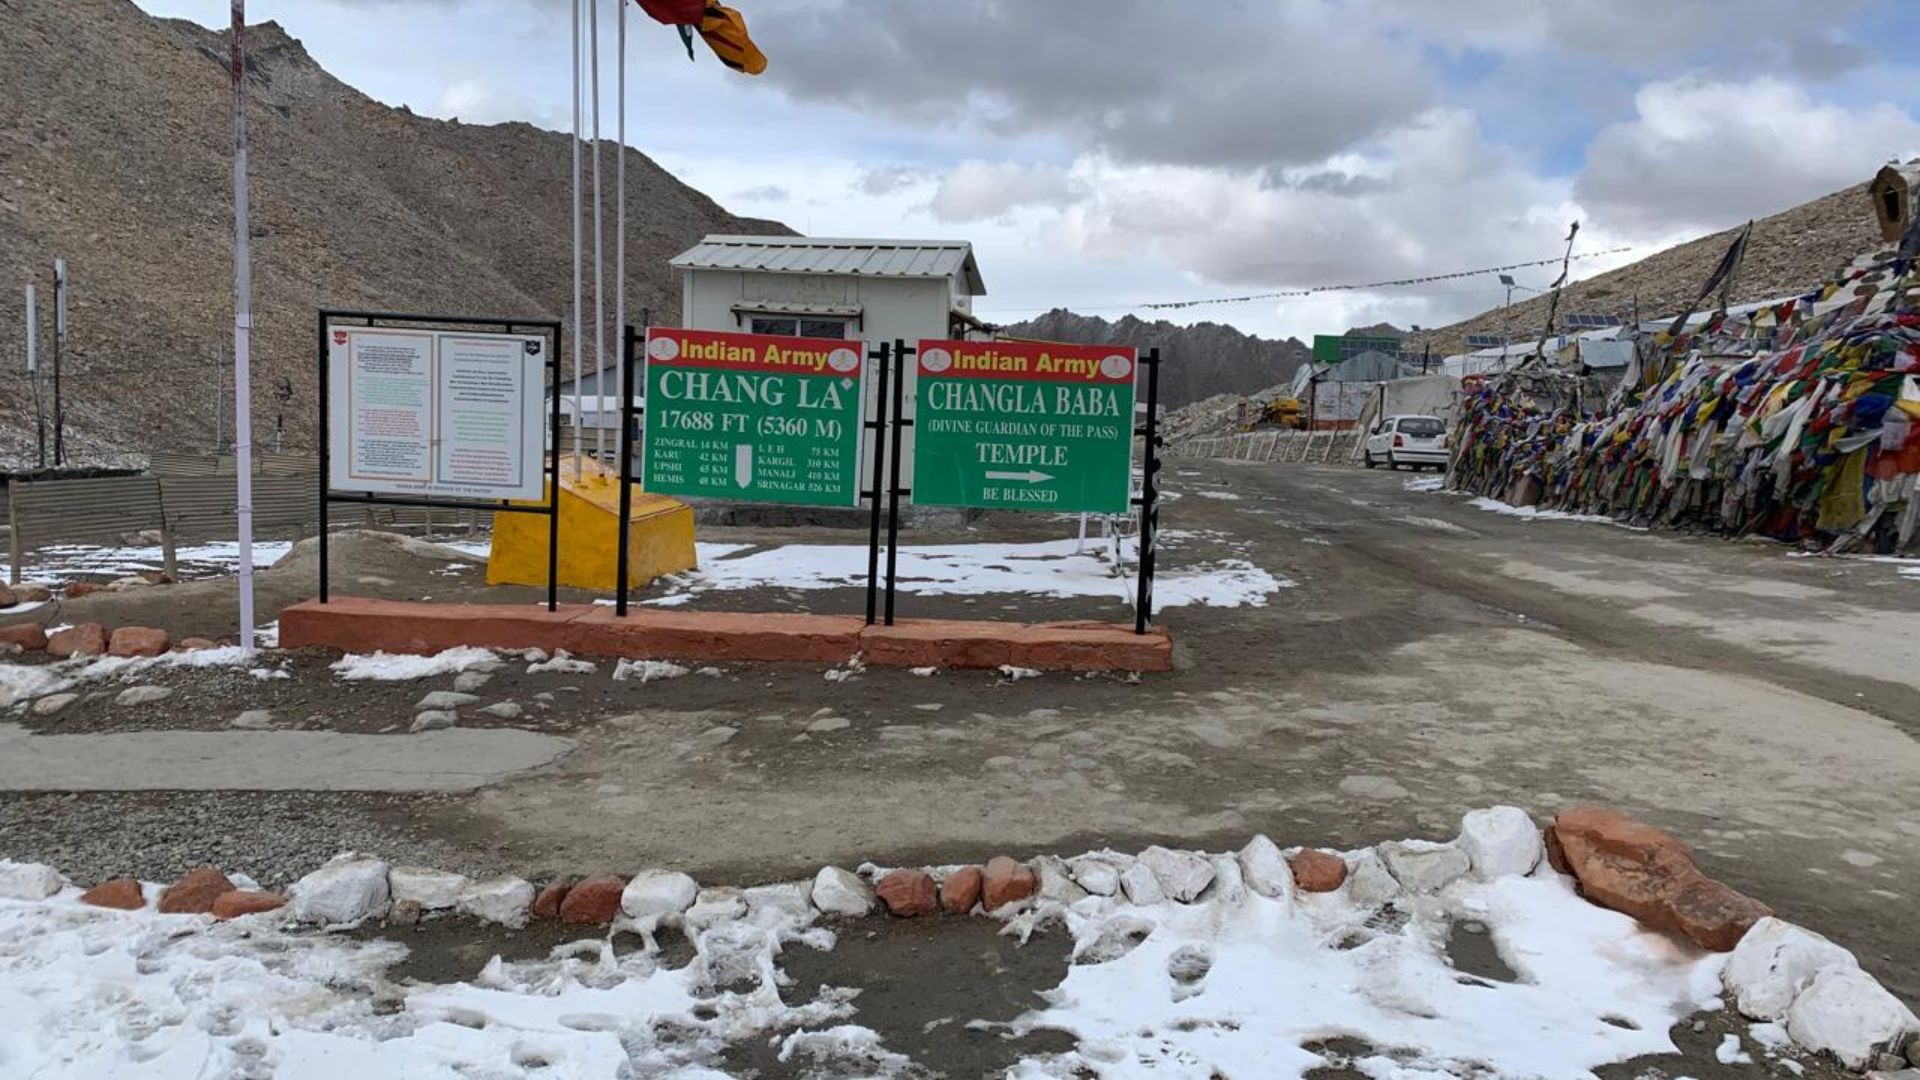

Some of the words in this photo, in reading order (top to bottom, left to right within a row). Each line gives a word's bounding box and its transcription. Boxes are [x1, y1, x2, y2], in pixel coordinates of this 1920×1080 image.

[681, 339, 755, 362] Indian
[764, 344, 829, 370] Army
[953, 350, 1027, 371] Indian
[1036, 353, 1101, 378] Army
[659, 370, 787, 406] CHANG
[797, 379, 843, 410] LA
[928, 382, 1046, 413] CHANGLA
[1056, 387, 1120, 417] BABA
[660, 411, 714, 430] 17688
[721, 414, 749, 432] FT
[757, 416, 807, 438] (5360
[815, 419, 842, 440] M)
[928, 421, 972, 433] (DIVINE
[976, 422, 1037, 435] GUARDIAN
[1041, 424, 1056, 436] OF
[1060, 425, 1084, 438] THE
[1087, 426, 1118, 440] PASS)
[654, 438, 698, 449] ZINGRAL
[700, 441, 710, 449] 14
[712, 441, 728, 450] KM
[654, 450, 682, 459] KARU
[699, 453, 710, 461] 42
[711, 453, 727, 462] KM
[822, 448, 839, 457] KM
[976, 443, 1068, 466] TEMPLE
[758, 456, 796, 466] KARGIL
[823, 460, 839, 469] KM
[712, 465, 728, 474] KM
[758, 468, 796, 479] MANALI
[824, 472, 840, 481] KM
[653, 473, 684, 484] HEMIS
[710, 477, 727, 486] KM
[757, 481, 805, 491] SRINAGAR
[825, 484, 841, 493] KM
[983, 488, 998, 500] BE
[1003, 489, 1057, 502] BLESSED
